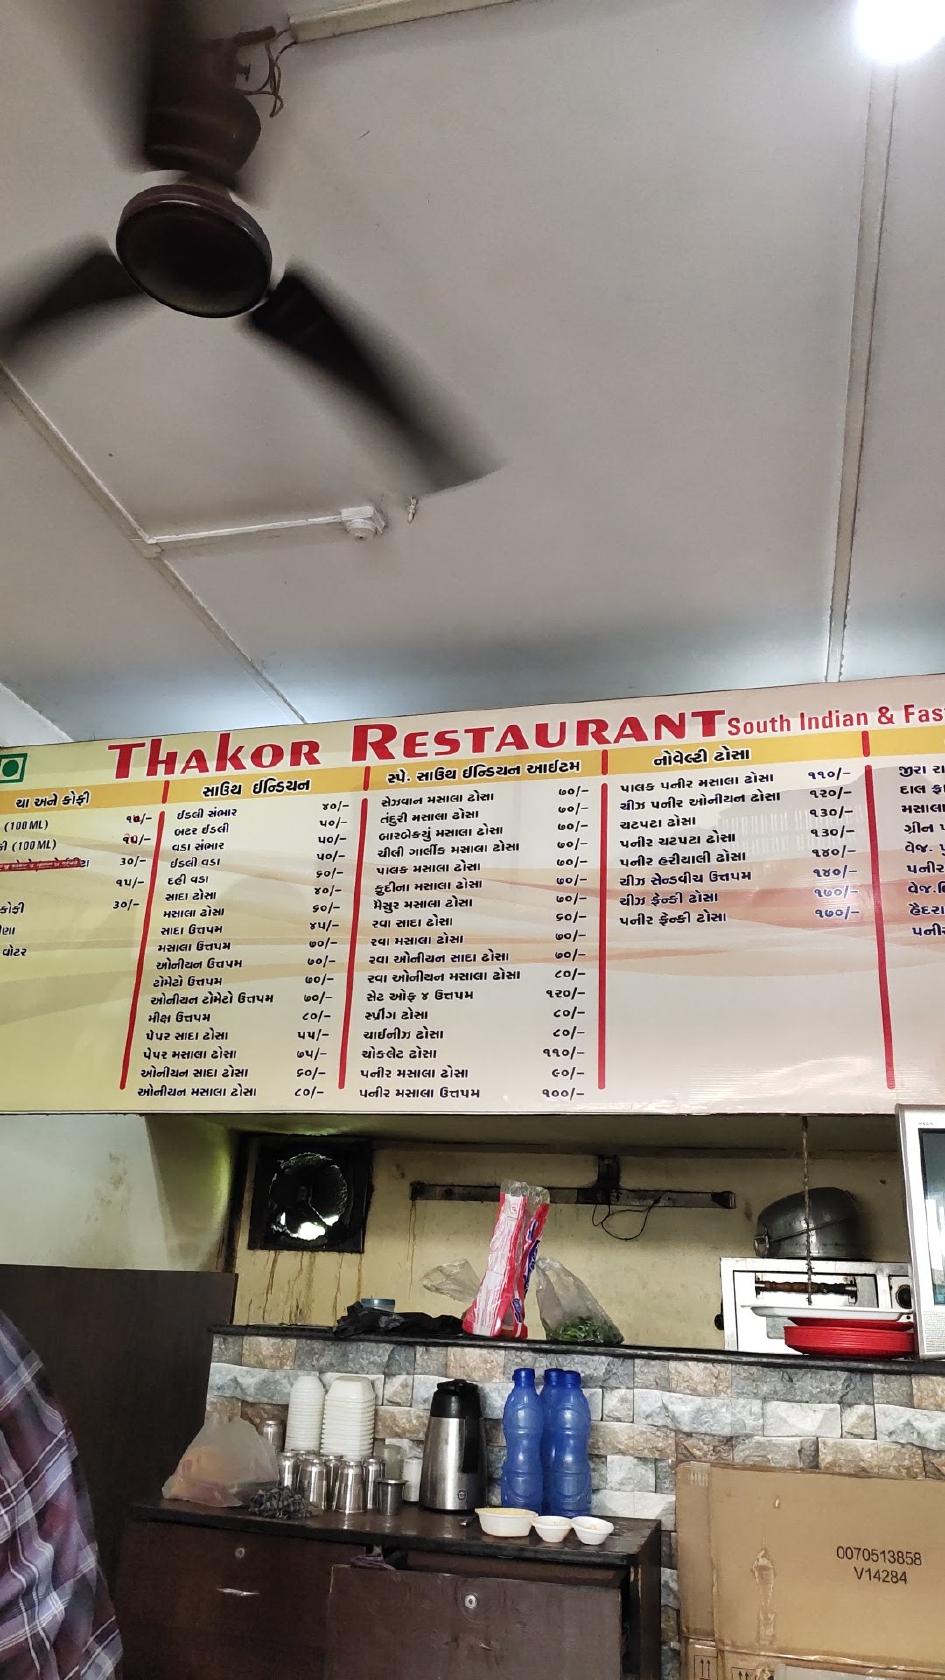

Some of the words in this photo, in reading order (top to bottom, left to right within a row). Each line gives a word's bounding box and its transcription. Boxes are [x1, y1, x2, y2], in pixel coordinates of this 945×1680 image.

[351, 710, 725, 762] RESTAURANT
[728, 717, 791, 736] South
[800, 710, 868, 731] Indian
[877, 706, 895, 725] &
[904, 704, 945, 723] Fas
[653, 748, 707, 766] નોવેલ્ટી
[714, 746, 750, 761] ઢોસા
[417, 767, 457, 781] સાઉથ
[203, 781, 242, 797] સાઉથ
[620, 783, 655, 793] પાલક
[660, 777, 693, 790] પનીર
[698, 776, 739, 788] મસાલા
[744, 771, 774, 784] ઢોસા
[900, 785, 926, 794] દાલ
[16, 799, 29, 808] ચા
[34, 794, 57, 807] અને
[62, 791, 90, 805] કોફી
[427, 794, 463, 804] મસાલા
[467, 789, 494, 802] ઢોસા
[619, 799, 646, 811] ચીઝ
[650, 796, 683, 809] પનીર
[688, 793, 746, 807] ઓનીયન
[750, 788, 780, 802] ઢોસા
[177, 808, 204, 820] ઈડલી
[207, 806, 237, 818] સંભાર
[380, 811, 408, 827] તંદુરી
[411, 812, 448, 822] મસાલા
[451, 807, 479, 820] ઢોસા
[174, 827, 198, 837] બટર
[201, 822, 229, 835] ઈડલી
[619, 819, 662, 830] ચટપટા
[667, 814, 696, 827] ઢોસા
[435, 828, 472, 838] મસાલા
[476, 822, 503, 836] ઢોસા
[171, 843, 191, 852] વડા
[194, 838, 224, 851] સંભાર
[619, 835, 653, 849] પનીર
[657, 835, 701, 846] ચટપટા
[706, 829, 736, 844] ઢોસા
[377, 845, 404, 858] ચીલી
[450, 844, 488, 854] મસાલા
[492, 839, 519, 852] ઢોસા
[170, 857, 197, 868] ઈડલી
[201, 858, 220, 867] વડા
[619, 854, 653, 867] પનીર
[658, 850, 711, 866] હરીયાલી
[716, 848, 746, 863] ઢોસા
[376, 865, 409, 876] પાલક
[412, 864, 449, 873] મસાલા
[453, 859, 481, 872] ઢોસા
[167, 873, 187, 886] દહી
[190, 875, 209, 884] વડા
[414, 881, 451, 891] મસાલા
[455, 876, 482, 890] ઢોસા
[619, 874, 646, 887] ચીઝ
[709, 870, 751, 883] ઉત્તપમ
[165, 892, 189, 902] સાદા
[192, 888, 217, 901] ઢોસા
[403, 899, 441, 909] મસાલા
[444, 894, 473, 908] ઢોસા
[620, 894, 646, 906] ચીઝ
[689, 890, 718, 903] ઢોસા
[163, 909, 196, 919] મસાલા
[199, 904, 225, 917] ઢોસા
[619, 912, 654, 926] પનીર
[696, 908, 726, 923] ઢોસા
[372, 919, 391, 929] રવા
[395, 919, 422, 928] સાદા
[426, 913, 453, 927] ઢોસા
[160, 926, 184, 936] સાદા
[188, 923, 223, 935] ઉત્તપમ
[157, 943, 192, 953] મસાલા
[196, 940, 231, 951] ઉત્તપમ
[370, 937, 390, 947] રવા
[394, 936, 432, 946] મસાલા
[436, 931, 463, 945] ઢોસા
[155, 957, 203, 970] ઓનીયન
[206, 957, 242, 969] ઉત્તપમ
[368, 955, 389, 965] રવા
[393, 950, 446, 964] ઓનીયન
[450, 953, 477, 963] સાદા
[481, 948, 509, 962] ઢોસા
[152, 974, 183, 988] ટોમેટો
[187, 975, 223, 987] ઉત્તપમ
[367, 974, 388, 984] રવા
[391, 968, 445, 983] ઓનીયન
[449, 972, 487, 981] મસાલા
[492, 967, 520, 981] ઢોસા
[150, 992, 199, 1005] ઓનીયન
[201, 990, 233, 1005] ટોમેટો
[237, 992, 274, 1004] ઉત્તપમ
[366, 989, 385, 1002] સેટ
[421, 992, 429, 1001] ૪
[434, 989, 474, 1000] ઉત્તપમ
[175, 1011, 211, 1023] ઉત્તપમ
[401, 1006, 428, 1020] ઢોસા
[145, 1029, 171, 1041] પેપર
[174, 1032, 199, 1041] સાદા
[202, 1027, 228, 1041] ઢોસા
[415, 1025, 444, 1040] ઢોસા
[143, 1047, 168, 1060] પેપર
[171, 1050, 207, 1060] મસાલા
[210, 1045, 237, 1059] ઢોસા
[408, 1045, 437, 1059] ઢોસા
[140, 1065, 189, 1078] ઓનીયન
[192, 1068, 218, 1078] સાદા
[221, 1064, 248, 1078] ઢોસા
[360, 1066, 392, 1079] પનીર
[396, 1069, 436, 1078] મસાલા
[440, 1064, 468, 1078] ઢોસા
[137, 1083, 186, 1097] ઓનીયન
[191, 1087, 227, 1097] મસાલા
[230, 1083, 256, 1097] ઢોસા
[359, 1085, 390, 1098] પનીર
[395, 1089, 434, 1098] મસાલા
[439, 1086, 480, 1098] ઉત્તપમ
[836, 1545, 922, 1566] 0070513858
[853, 1566, 908, 1584] V14284
